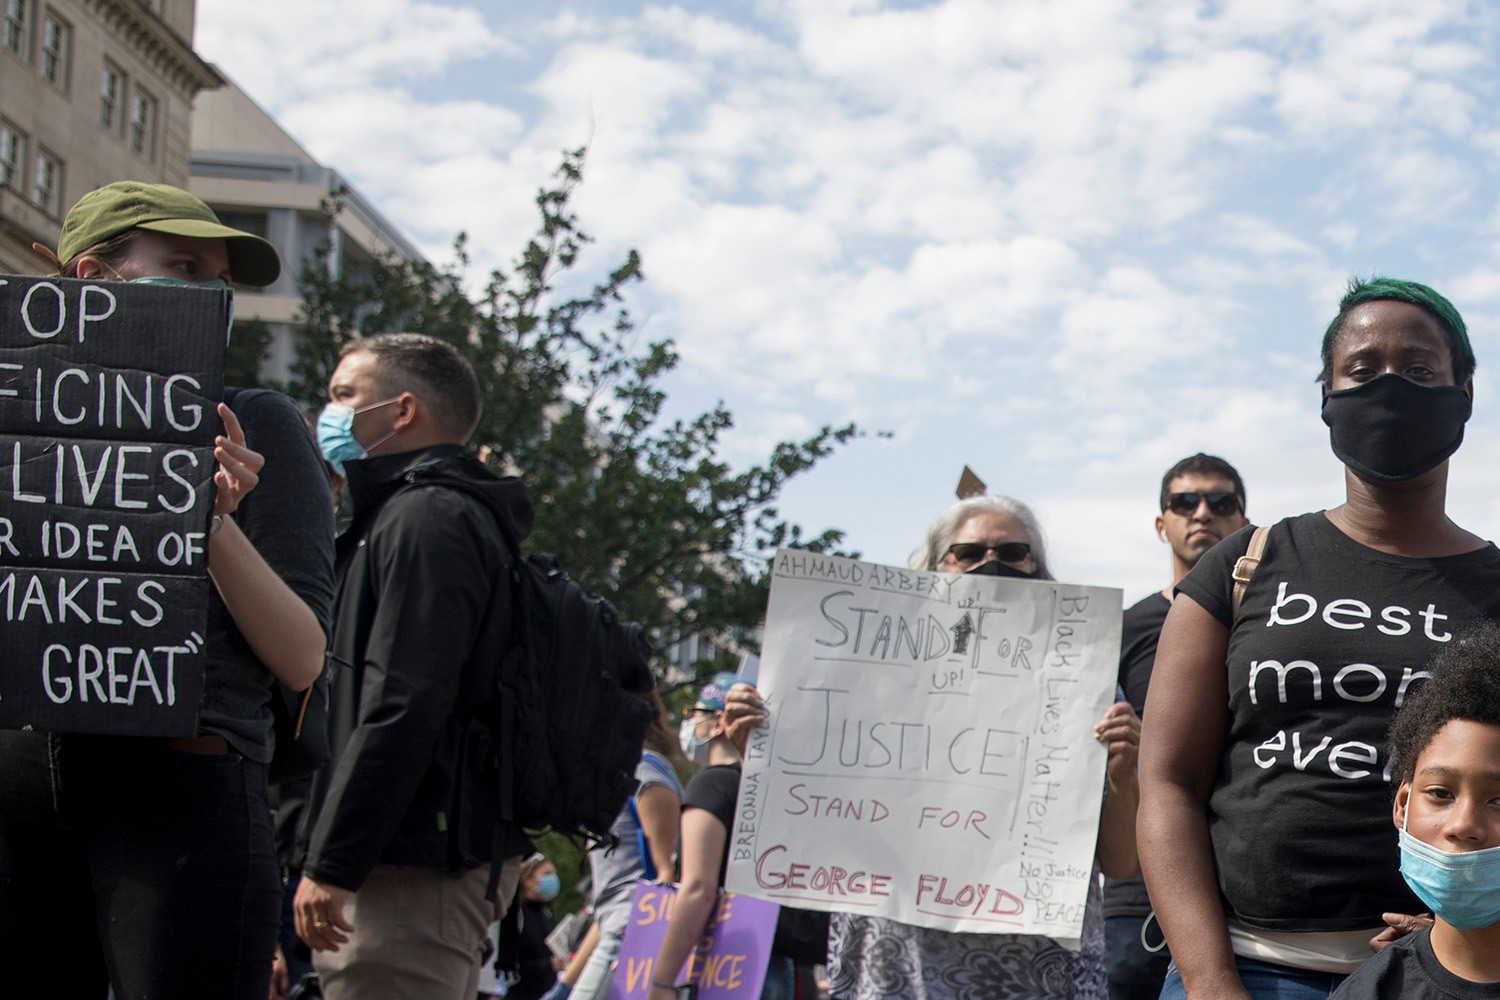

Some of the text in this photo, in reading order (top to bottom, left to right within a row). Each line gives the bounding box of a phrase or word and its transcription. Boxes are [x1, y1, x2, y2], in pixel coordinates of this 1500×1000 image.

[12, 440, 199, 514] LIVES
[42, 520, 140, 562] IDEA
[157, 531, 206, 567] OF
[779, 555, 962, 603] AHMAUD ARBERY
[815, 590, 1032, 671] STAND FOR
[1050, 594, 1090, 668] Black
[1266, 581, 1452, 642] best
[932, 668, 964, 691] UP!
[1039, 676, 1079, 735] Lives
[778, 687, 1020, 778] JUSTICE
[734, 771, 762, 862] BREONNA
[785, 783, 992, 840] STAND FOR
[755, 844, 1026, 917] GEORGE FLOYD
[1020, 861, 1041, 878] No
